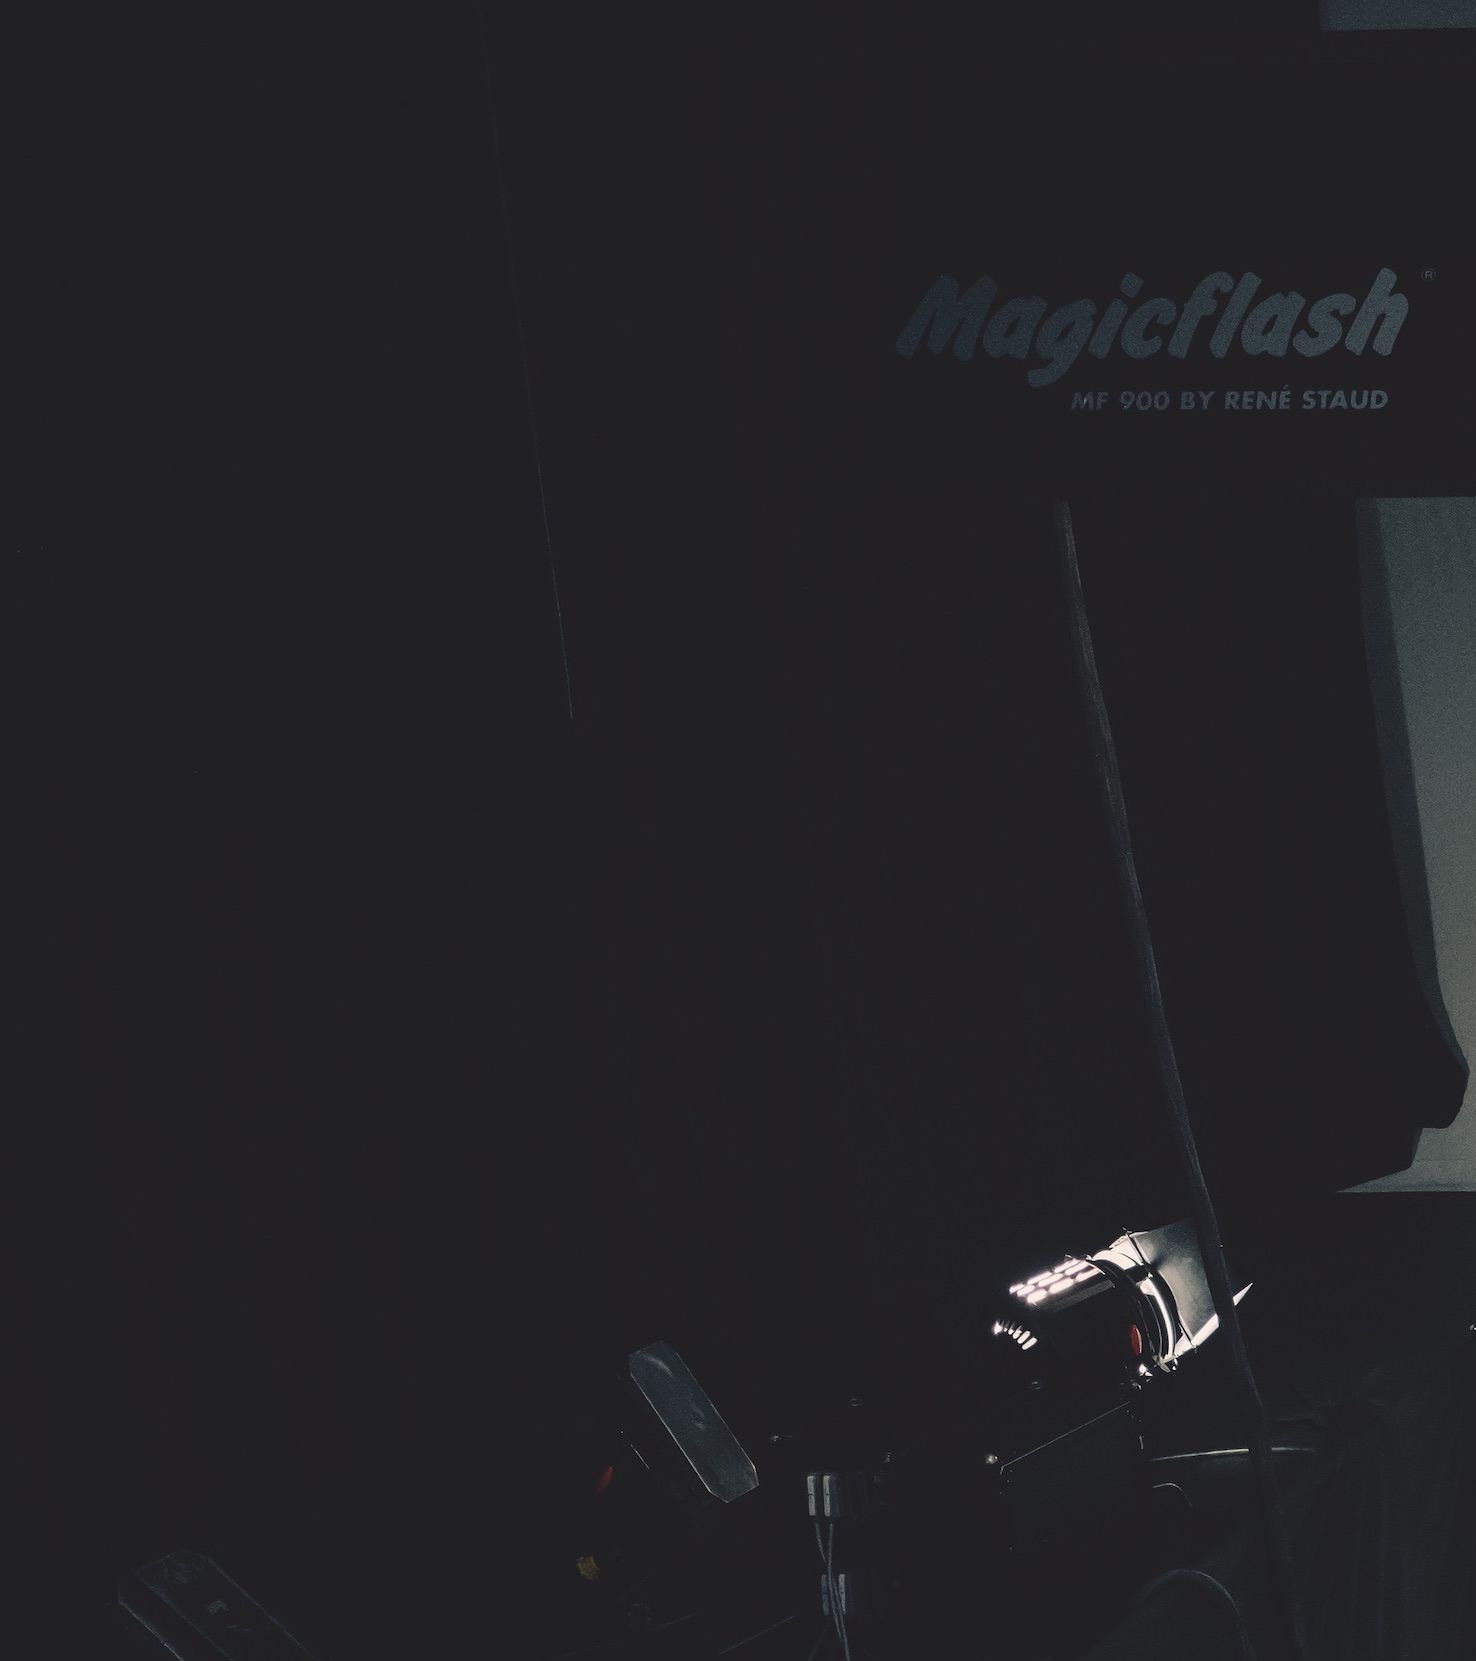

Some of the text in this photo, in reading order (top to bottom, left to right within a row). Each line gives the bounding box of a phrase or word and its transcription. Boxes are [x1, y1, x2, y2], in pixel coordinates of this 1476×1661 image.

[896, 267, 1409, 388] Magicflash
[1071, 383, 1389, 411] MF 900 BY RENÉ STAUD
